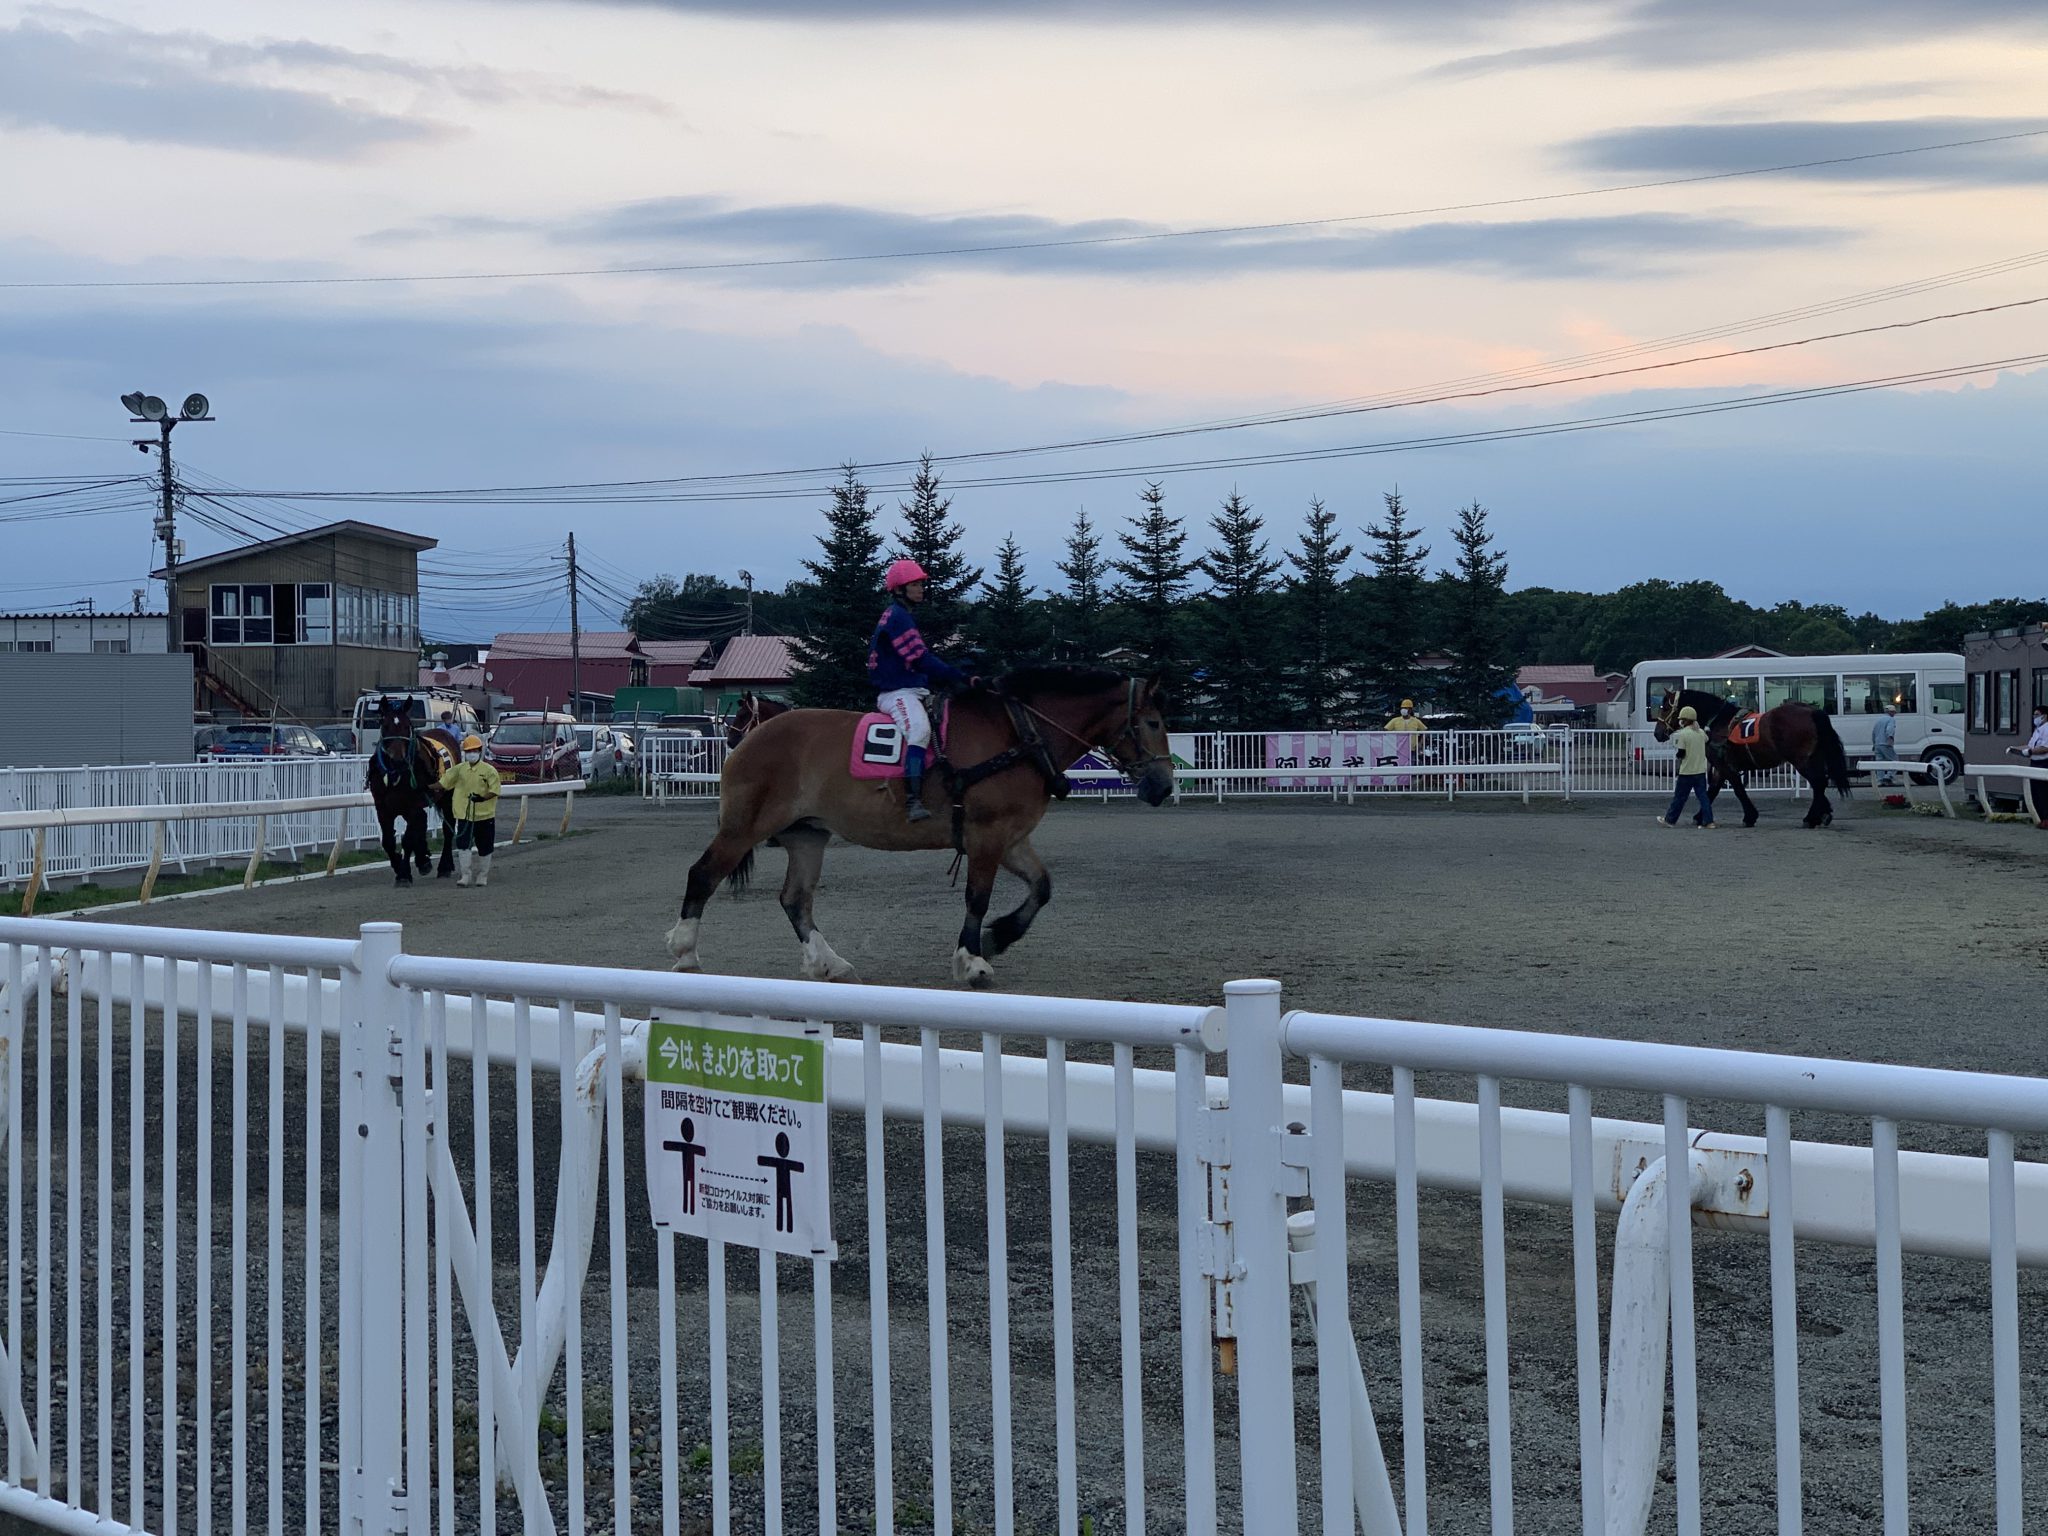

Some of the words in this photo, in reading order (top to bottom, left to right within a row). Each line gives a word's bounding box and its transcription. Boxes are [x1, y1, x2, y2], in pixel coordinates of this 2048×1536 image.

[864, 723, 902, 764] 9
[1742, 717, 1756, 737] 7
[659, 1036, 804, 1086] 今は、きょりを取って
[661, 1089, 802, 1129] 間隔を空けてご観戦ください。
